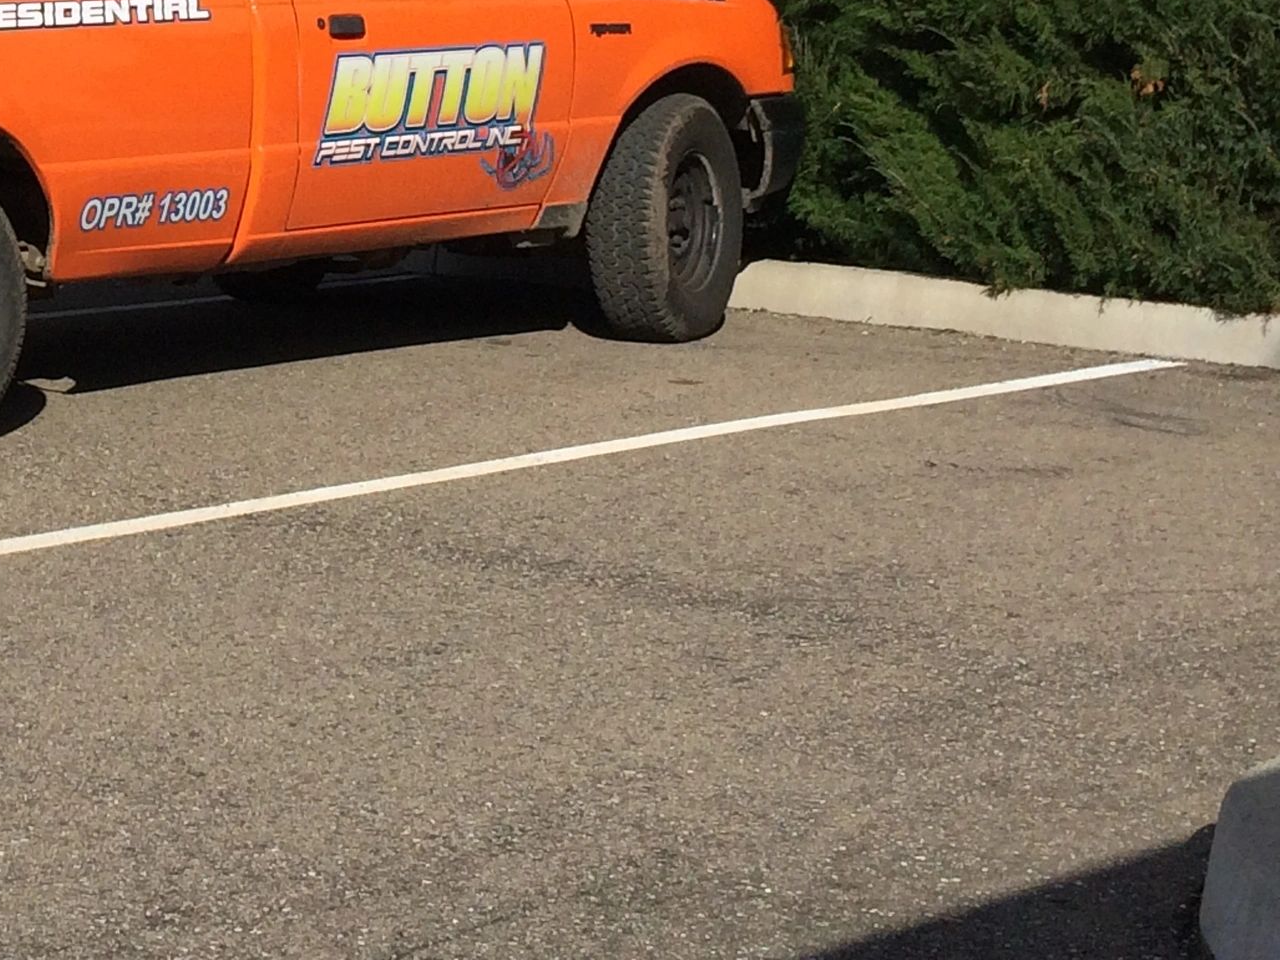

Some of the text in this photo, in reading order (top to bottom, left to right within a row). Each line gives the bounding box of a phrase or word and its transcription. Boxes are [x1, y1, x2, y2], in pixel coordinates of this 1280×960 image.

[324, 42, 545, 136] BUTTON
[315, 136, 381, 164] PEST
[381, 130, 482, 157] CONTROL
[80, 188, 229, 230] OPR# 13003
